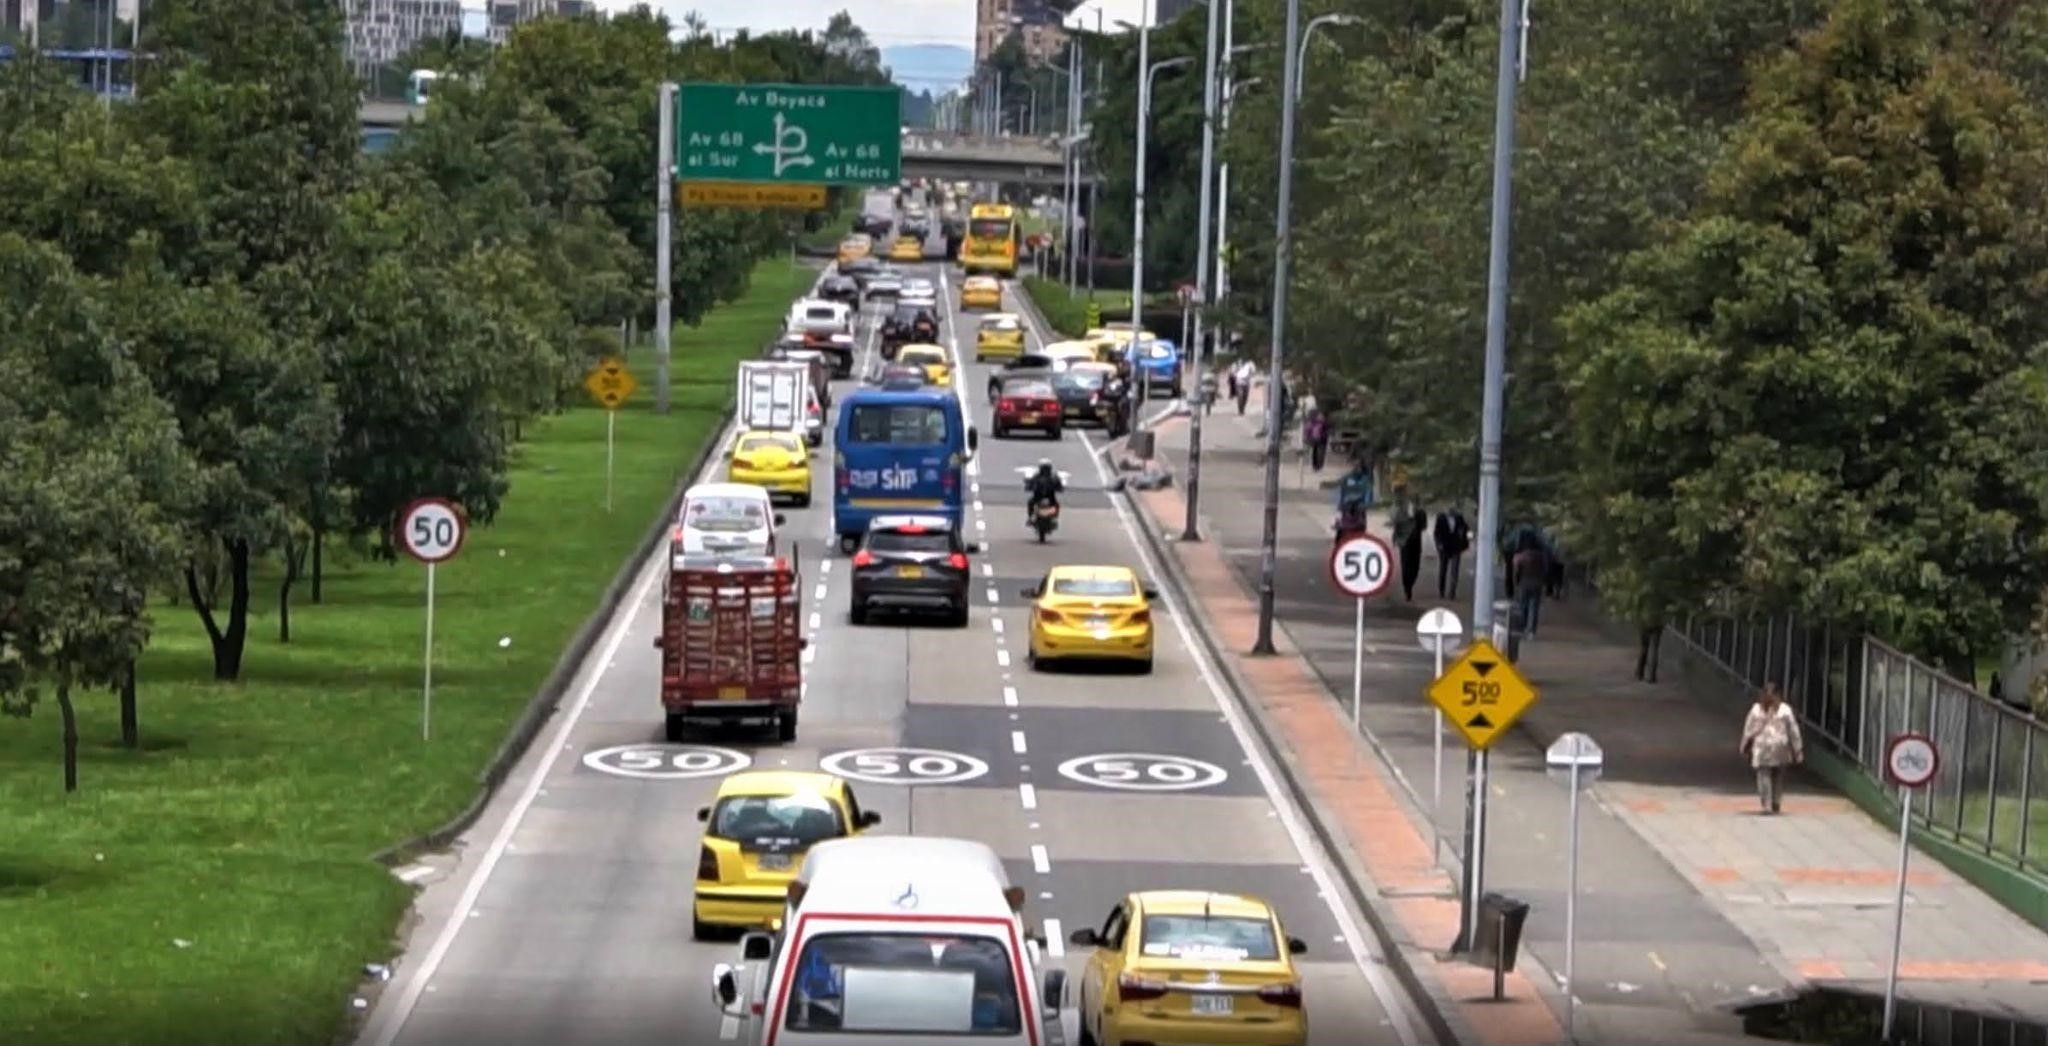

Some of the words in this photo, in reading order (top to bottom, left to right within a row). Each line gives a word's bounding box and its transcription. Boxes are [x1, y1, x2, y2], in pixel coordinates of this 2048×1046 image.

[736, 91, 759, 105] Av
[689, 131, 712, 147] Av
[719, 131, 743, 147] 68
[709, 151, 739, 167] Sur
[825, 142, 848, 158] Av
[856, 143, 880, 159] 68
[845, 163, 890, 180] Norte
[414, 516, 453, 547] 50
[1343, 551, 1383, 582] 50
[620, 750, 721, 769] 50
[856, 755, 957, 775] 50
[1093, 761, 1196, 782] 50
